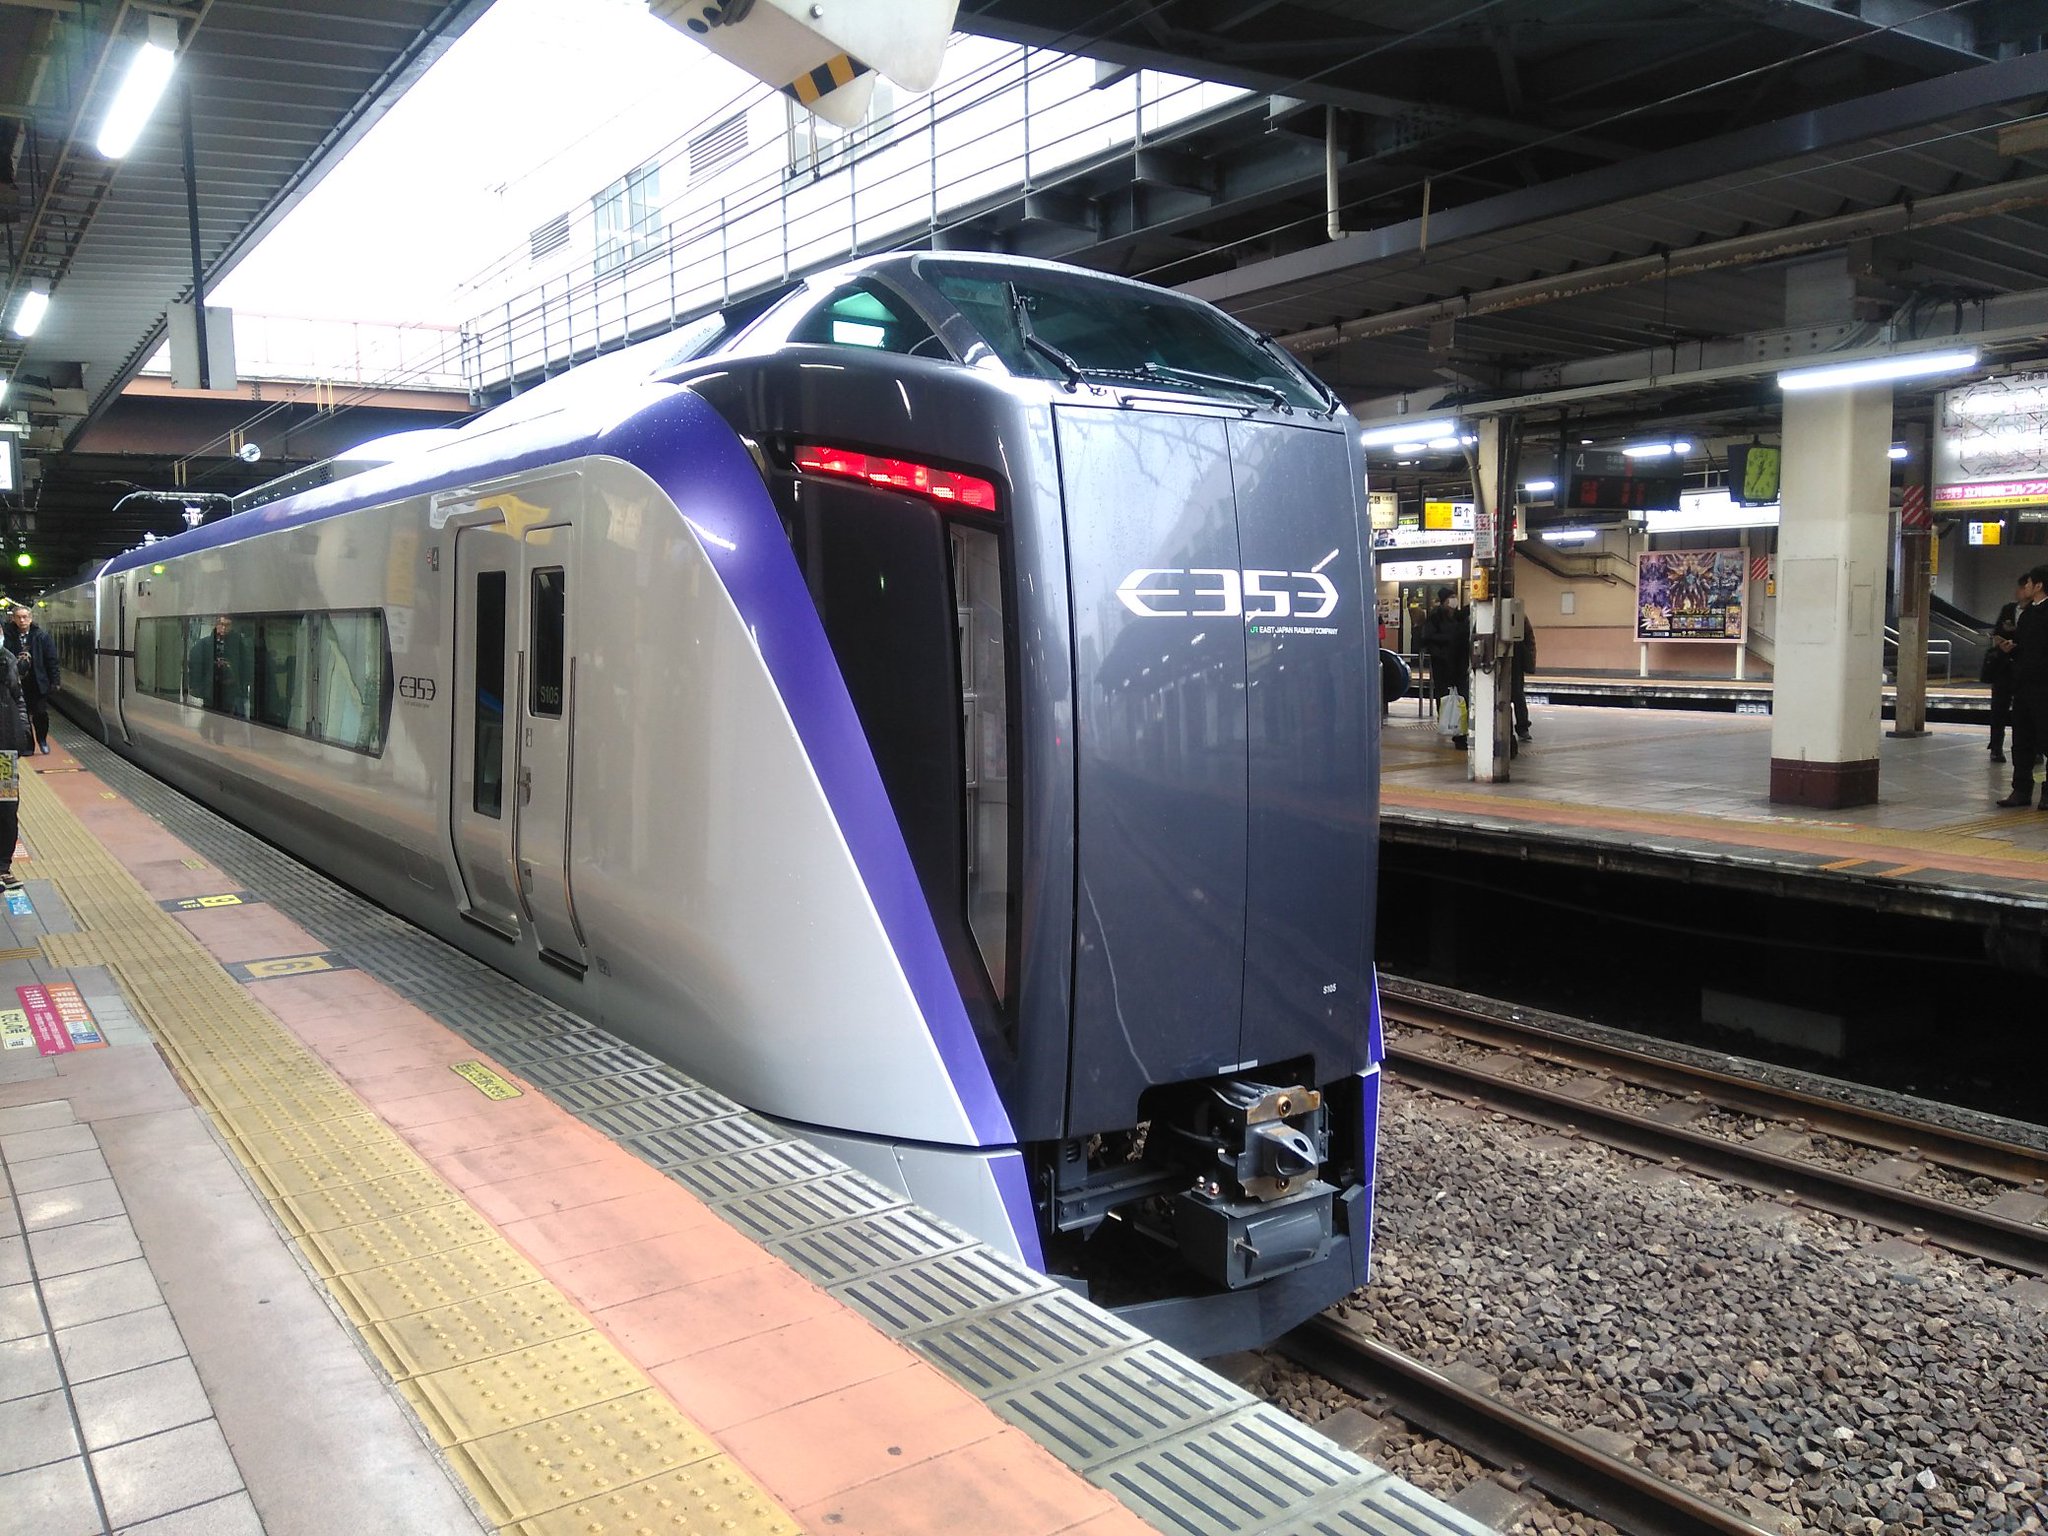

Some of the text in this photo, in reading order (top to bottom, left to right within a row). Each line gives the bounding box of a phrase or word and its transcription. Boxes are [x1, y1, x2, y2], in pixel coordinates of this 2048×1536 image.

[1575, 453, 1585, 471] 4
[1115, 568, 1339, 618] E353
[1259, 626, 1275, 634] EAST
[1275, 626, 1294, 634] JAPAN
[399, 676, 436, 701] E353
[540, 685, 559, 704] S105
[1322, 982, 1337, 995] S105
